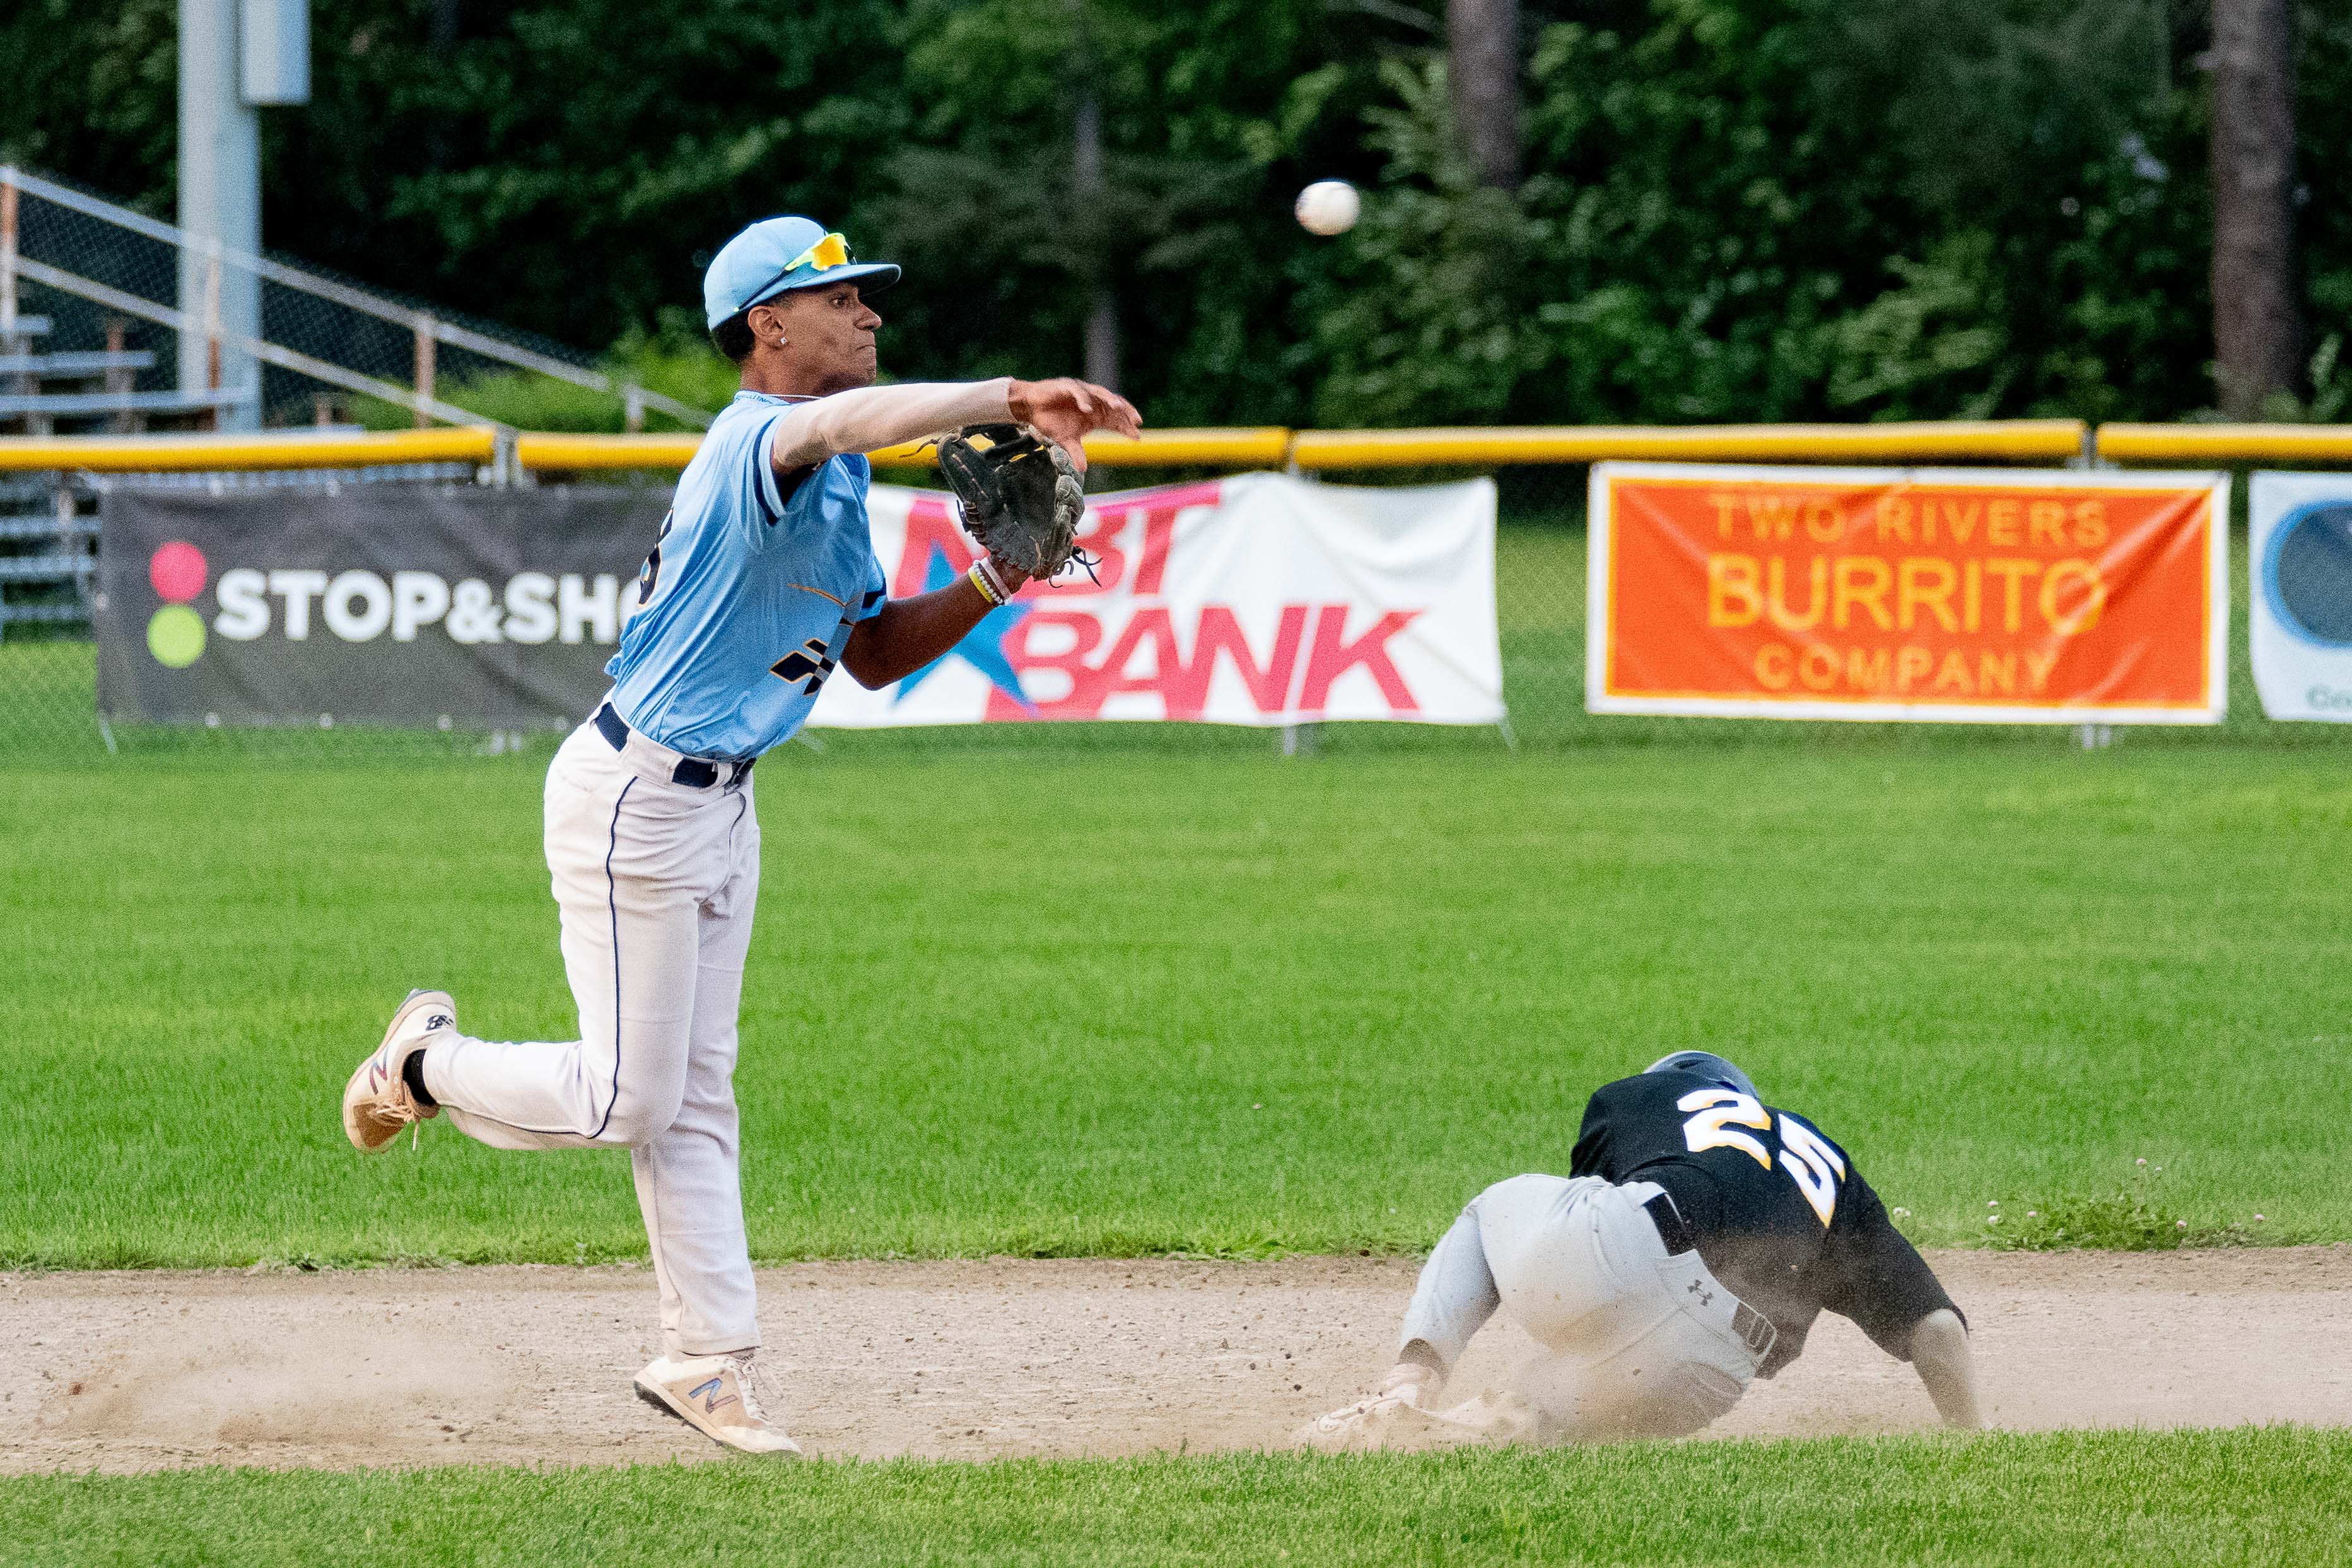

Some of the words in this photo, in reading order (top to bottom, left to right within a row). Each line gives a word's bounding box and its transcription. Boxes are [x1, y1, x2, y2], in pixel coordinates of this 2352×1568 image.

[1707, 492, 1846, 542] TWO
[1876, 498, 2110, 547] RIVERS
[1707, 553, 2108, 635] BURRITO
[982, 606, 1423, 721] BANK
[1753, 644, 2050, 692] COMPANY
[1677, 1089, 1846, 1227] 25
